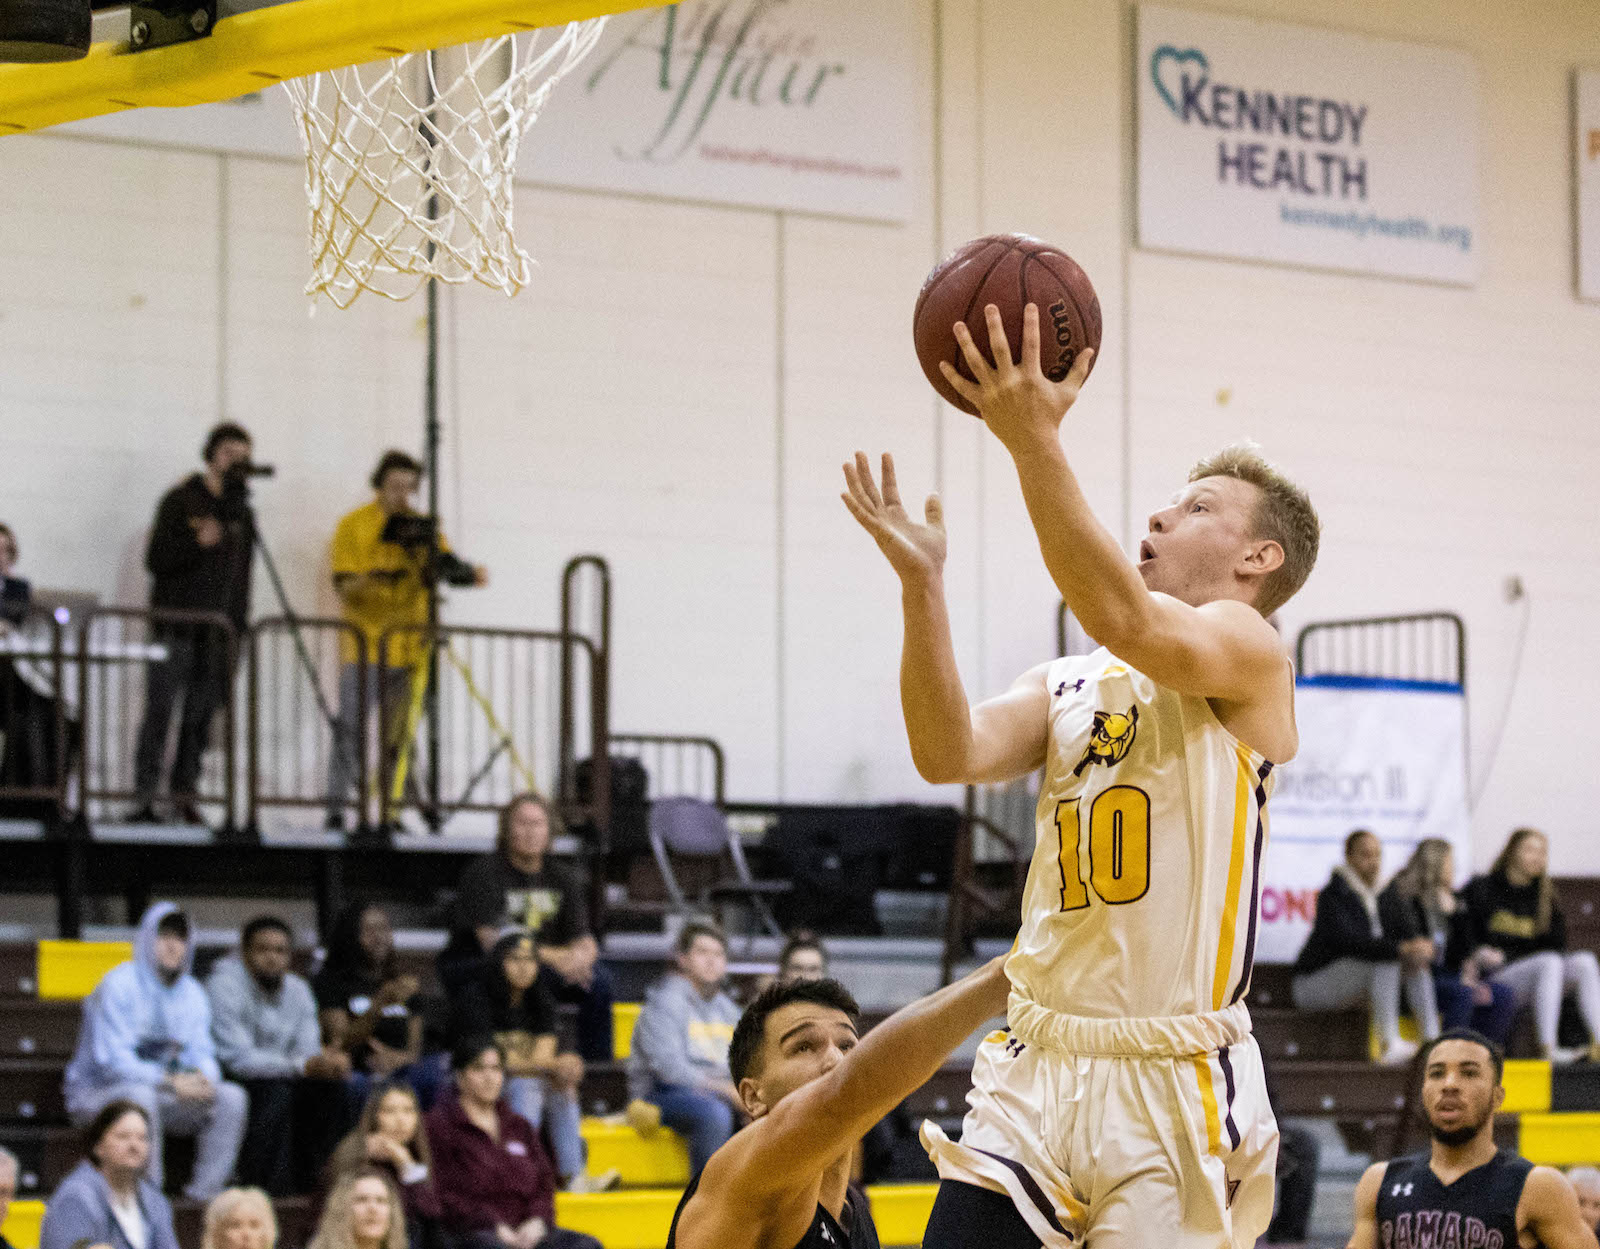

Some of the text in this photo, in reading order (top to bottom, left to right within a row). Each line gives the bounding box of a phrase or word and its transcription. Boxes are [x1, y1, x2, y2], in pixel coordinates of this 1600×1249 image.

[1180, 71, 1368, 147] KENNEDY
[1217, 140, 1368, 201] HEALTH
[1054, 784, 1151, 912] 10
[1262, 887, 1320, 923] ON
